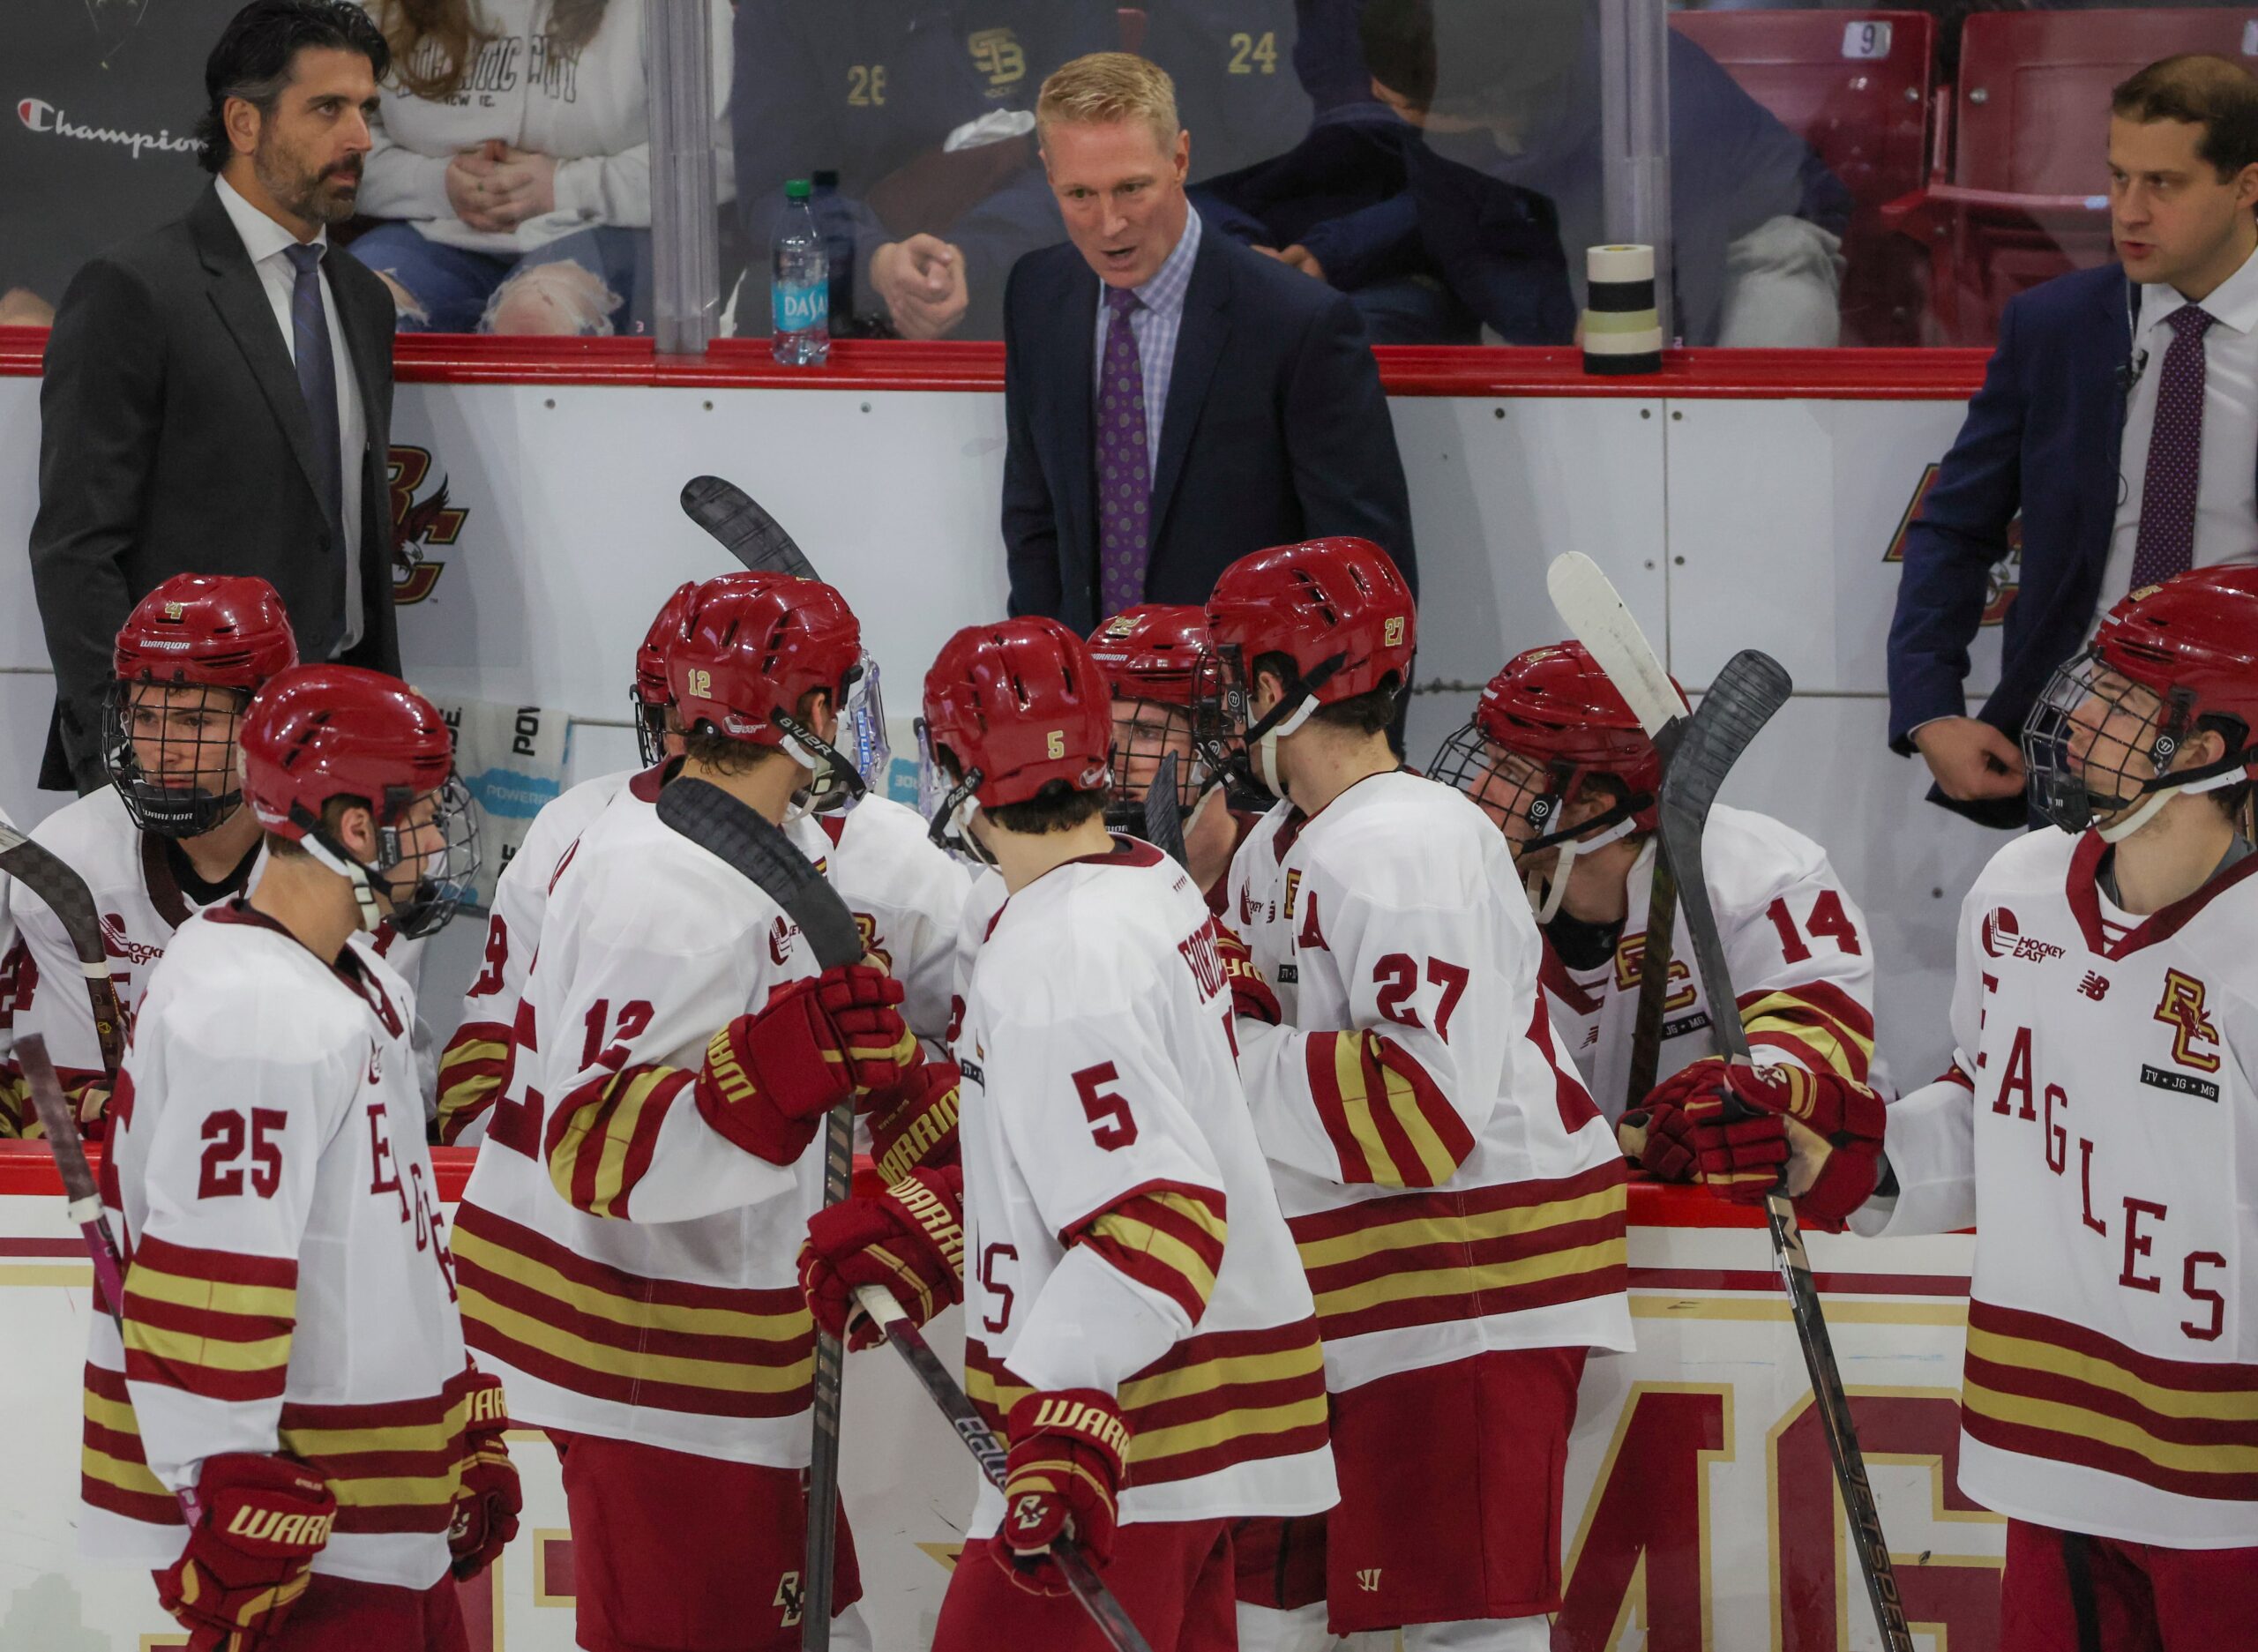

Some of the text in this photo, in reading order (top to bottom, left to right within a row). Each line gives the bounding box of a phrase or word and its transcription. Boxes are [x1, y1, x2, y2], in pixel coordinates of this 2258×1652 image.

[1228, 32, 1277, 74] 24
[1859, 24, 1876, 54] 9
[18, 98, 208, 159] Champion
[164, 601, 183, 620] 4
[139, 639, 191, 650] WARRIOR
[1385, 616, 1405, 647] 27
[687, 668, 713, 699] 12
[1046, 729, 1065, 760] 5
[1766, 889, 1863, 965] 14
[2012, 946, 2046, 964] EAST
[2016, 937, 2067, 960] HOCKEY
[1372, 953, 1470, 1046] 27
[578, 998, 655, 1074] 12
[1689, 1015, 1706, 1029] MG
[2145, 1069, 2216, 1097] TV JG MG
[1071, 1060, 1139, 1152] 5
[198, 1106, 288, 1200] 25
